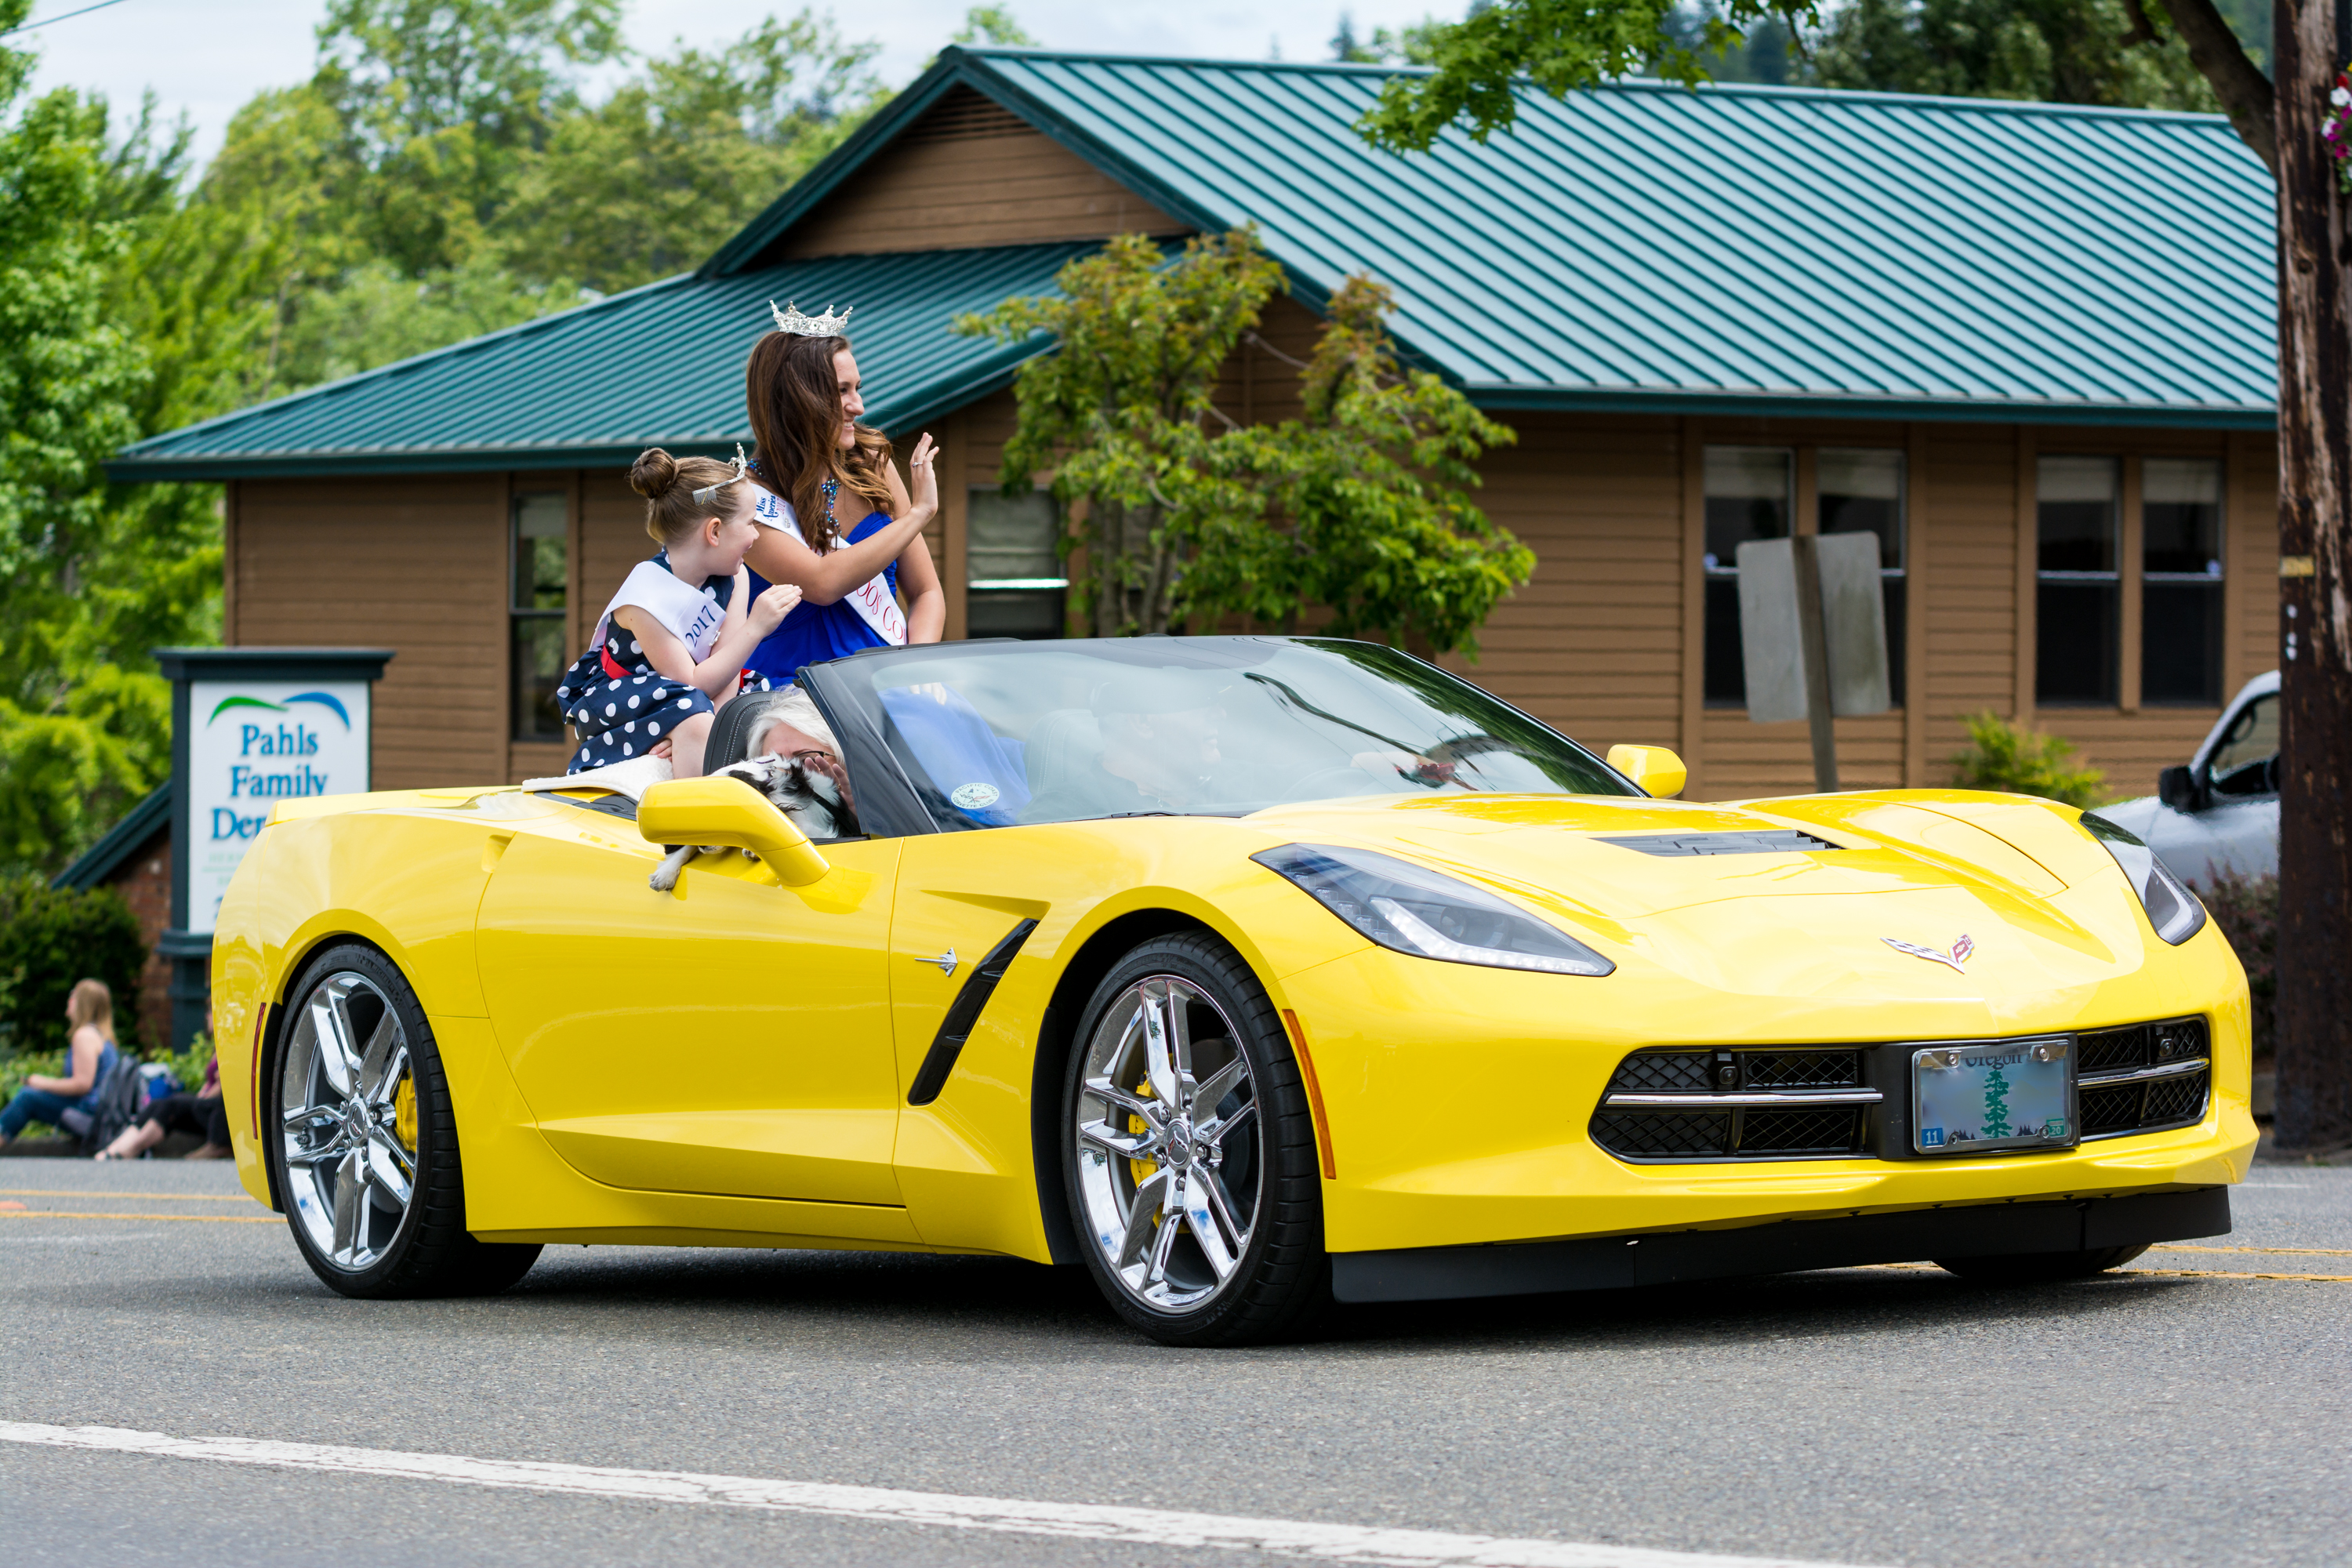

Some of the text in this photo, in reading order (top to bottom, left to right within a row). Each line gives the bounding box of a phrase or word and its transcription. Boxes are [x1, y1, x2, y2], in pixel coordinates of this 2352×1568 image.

[856, 581, 883, 615] oos
[684, 604, 716, 648] 2017
[240, 723, 318, 756] Pahls
[230, 764, 328, 797] Family
[955, 783, 998, 797] PACIFIC COAST
[953, 797, 994, 808] CORVETTE CLUB
[1926, 1130, 1939, 1144] 11
[2051, 1126, 2061, 1134] 20
